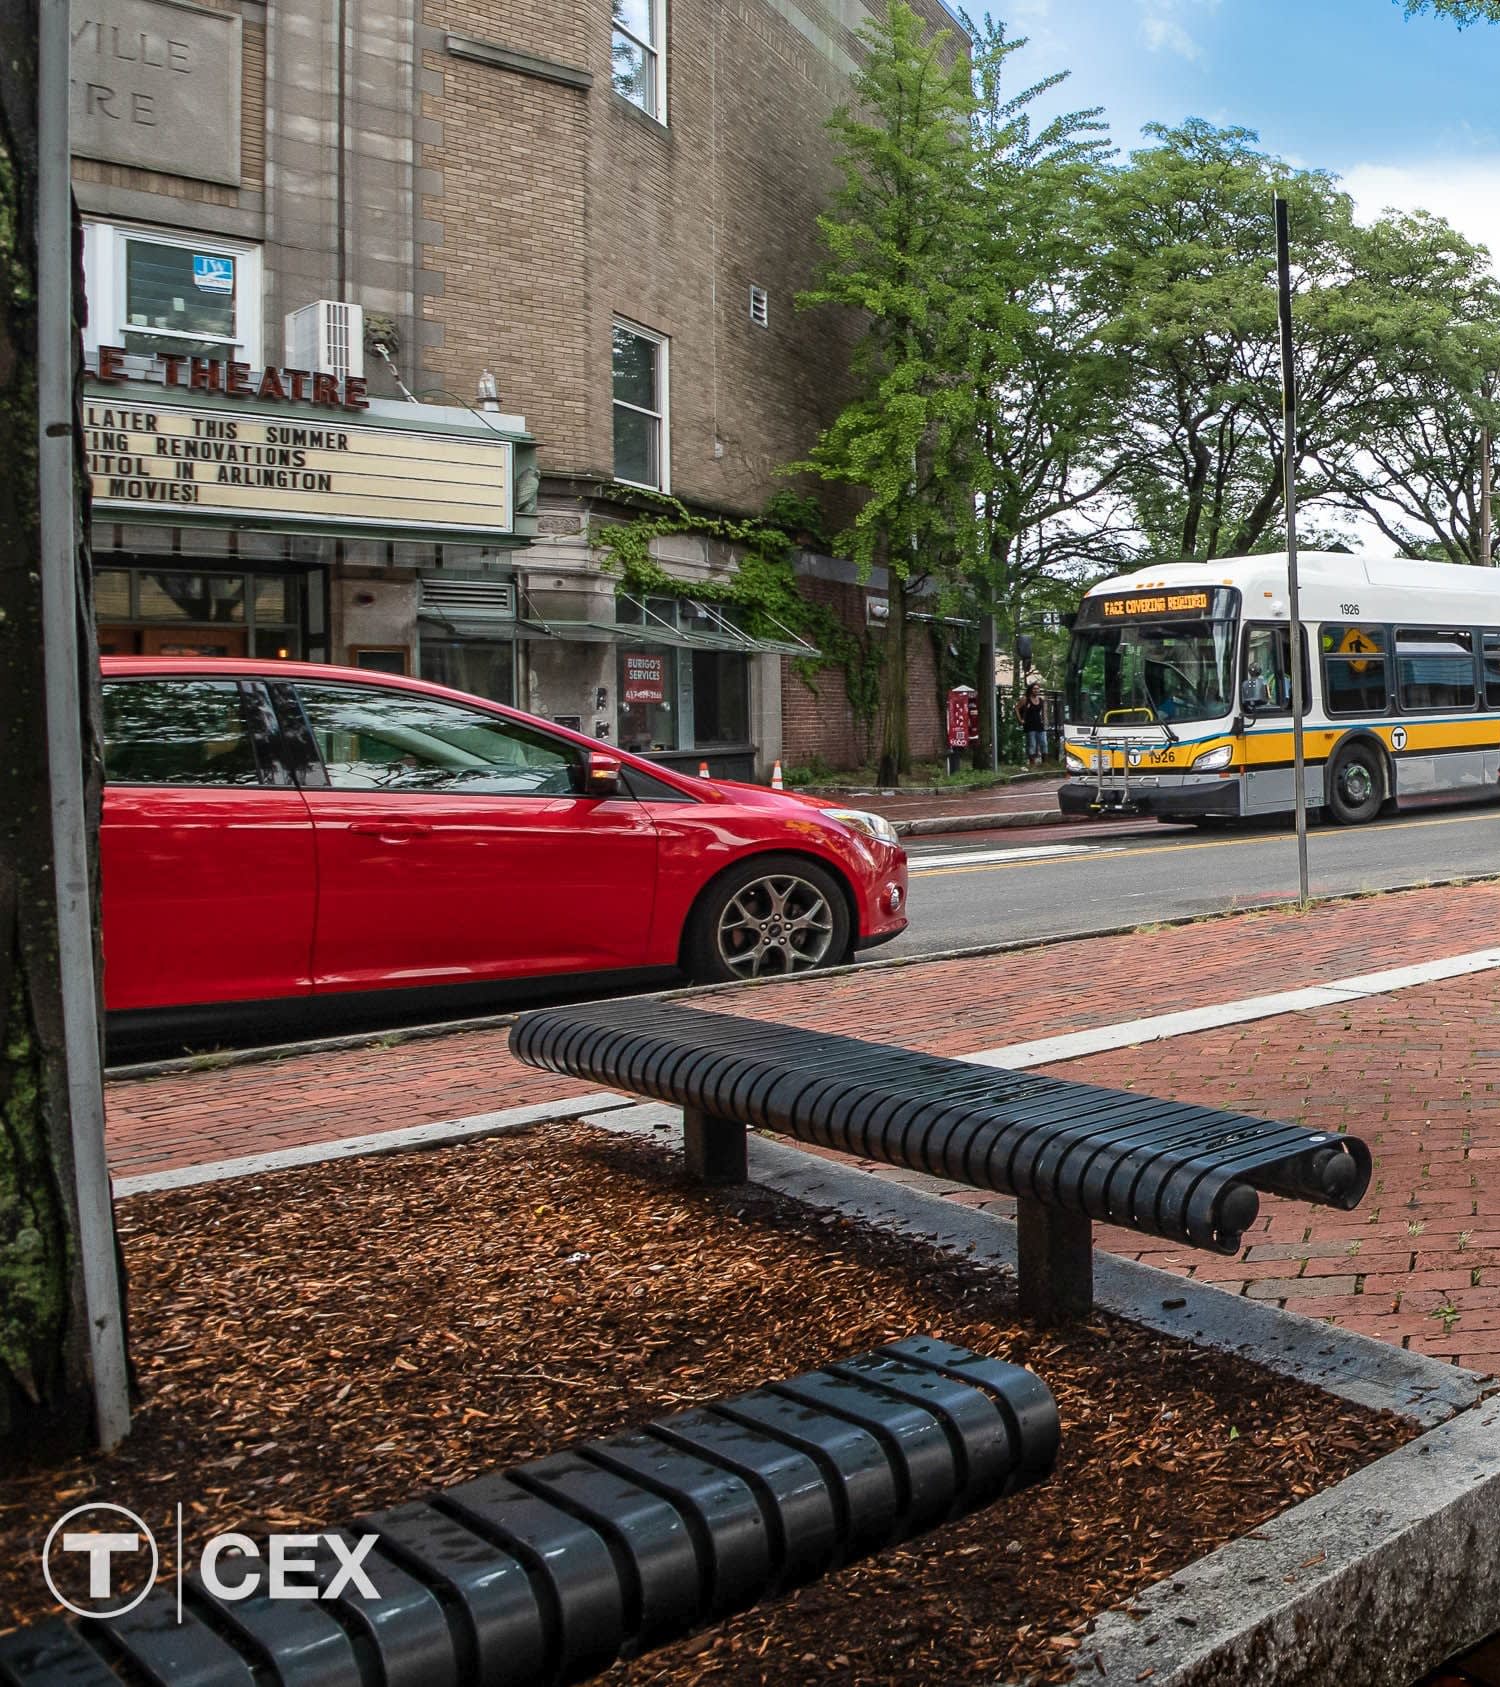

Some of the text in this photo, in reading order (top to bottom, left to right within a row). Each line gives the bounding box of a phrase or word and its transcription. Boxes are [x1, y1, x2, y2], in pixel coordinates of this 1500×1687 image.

[71, 79, 156, 127] RE
[155, 352, 370, 409] THEATRE
[88, 407, 349, 451] LATER THIS SUMMER
[84, 430, 306, 468] ING RENOVATIONS
[86, 454, 332, 492] ITOL IN ARLINGTON
[110, 479, 199, 503] MOVIES!
[1104, 593, 1207, 616] FACE COVERING REQUIRED
[1340, 603, 1360, 616] 1926
[629, 670, 660, 681] SERVICES
[1149, 751, 1176, 765] 1926
